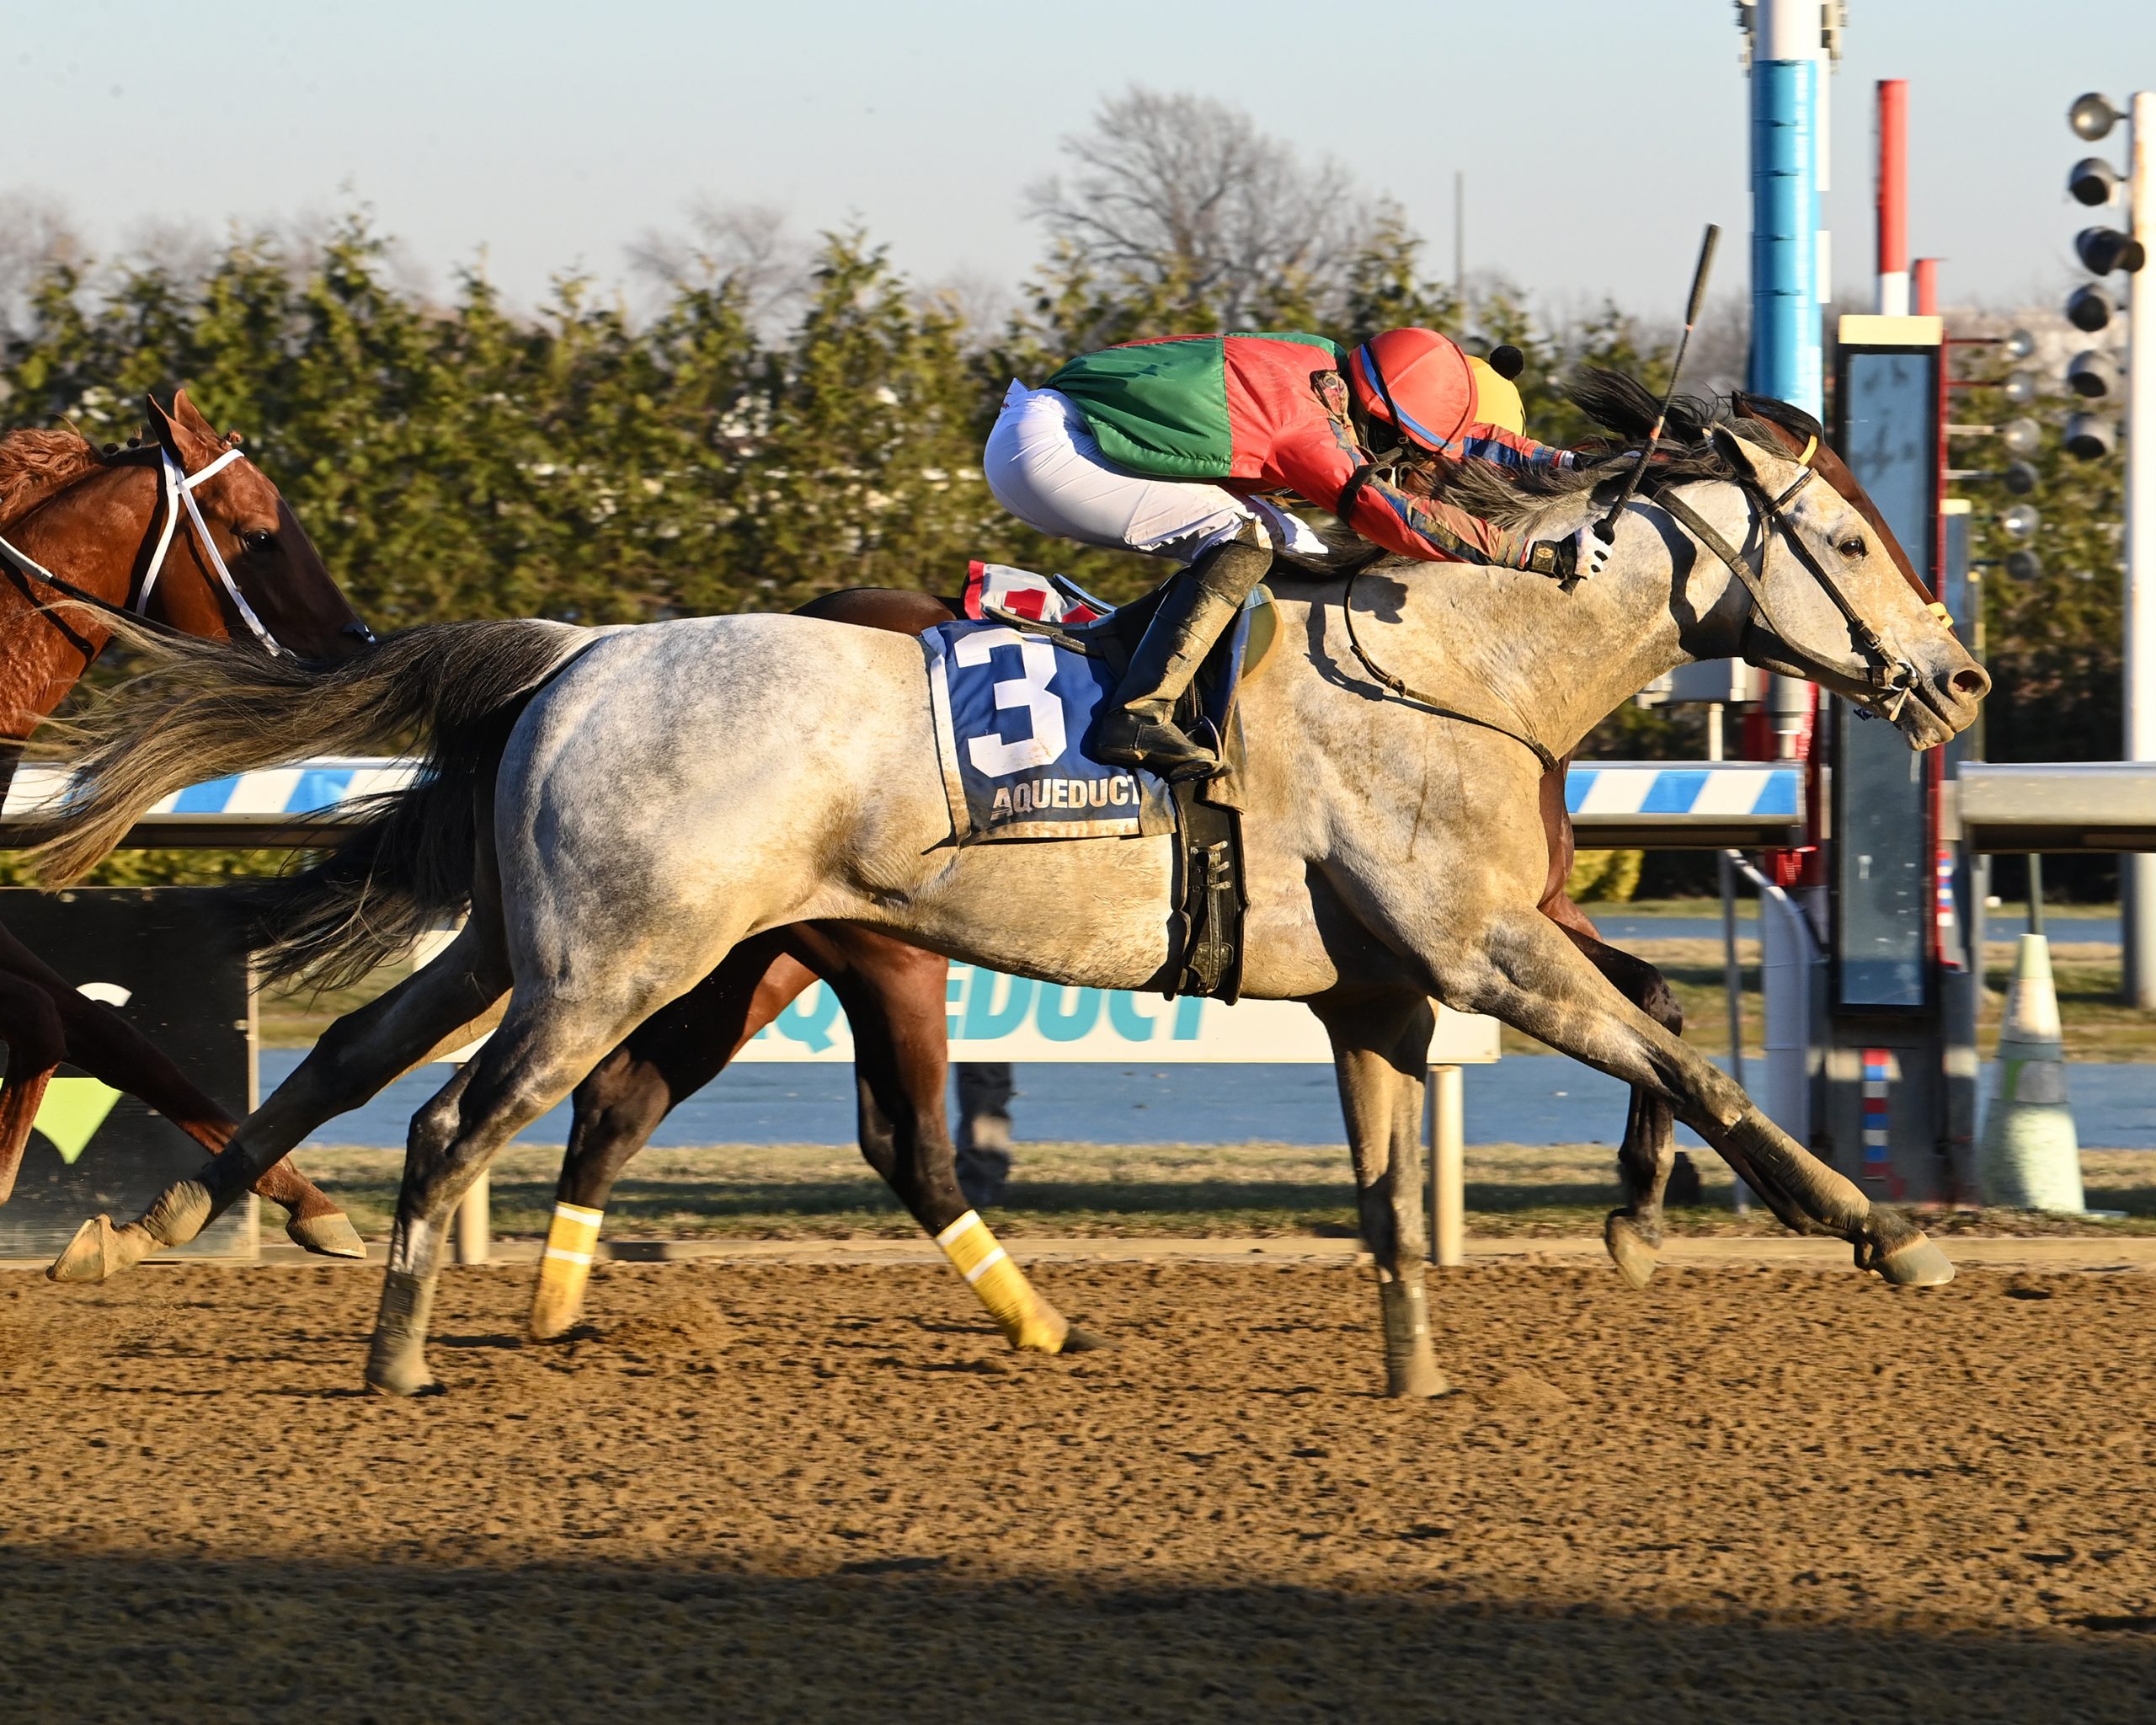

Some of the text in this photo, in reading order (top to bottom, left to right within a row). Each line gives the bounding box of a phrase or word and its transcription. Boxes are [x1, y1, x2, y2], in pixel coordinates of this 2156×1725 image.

[953, 628, 1068, 778] 3
[990, 775, 1140, 821] AQUEDUCT
[751, 959, 1208, 1054] QDUC
